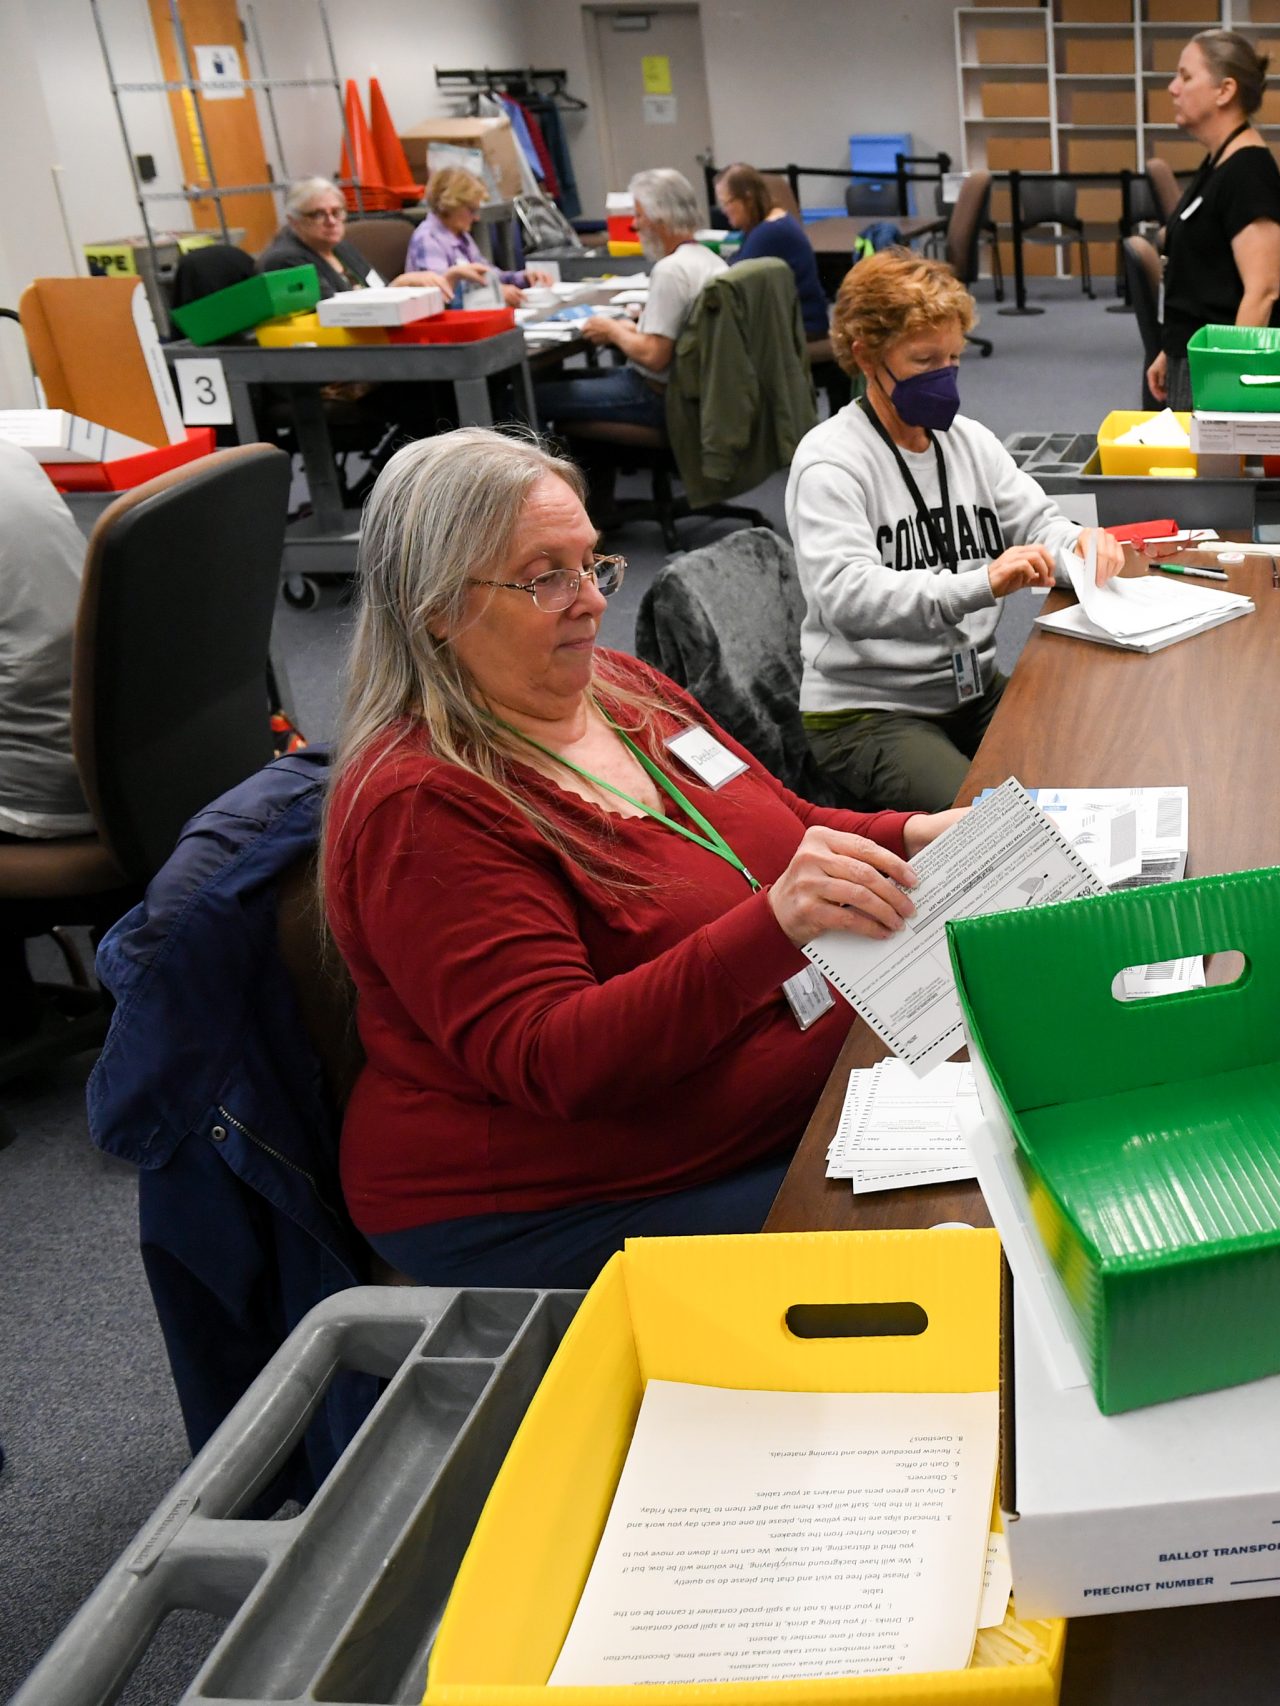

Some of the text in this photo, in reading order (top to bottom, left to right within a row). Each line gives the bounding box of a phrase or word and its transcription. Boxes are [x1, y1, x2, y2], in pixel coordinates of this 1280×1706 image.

[195, 376, 217, 405] 3
[807, 1449, 839, 1457] training
[925, 1486, 946, 1494] Only
[767, 1517, 794, 1525] please
[812, 1516, 841, 1524] yellow
[1158, 1549, 1209, 1562] BALLOT
[807, 1558, 857, 1566] background
[1083, 1577, 1214, 1597] PRECINCT NUMBER
